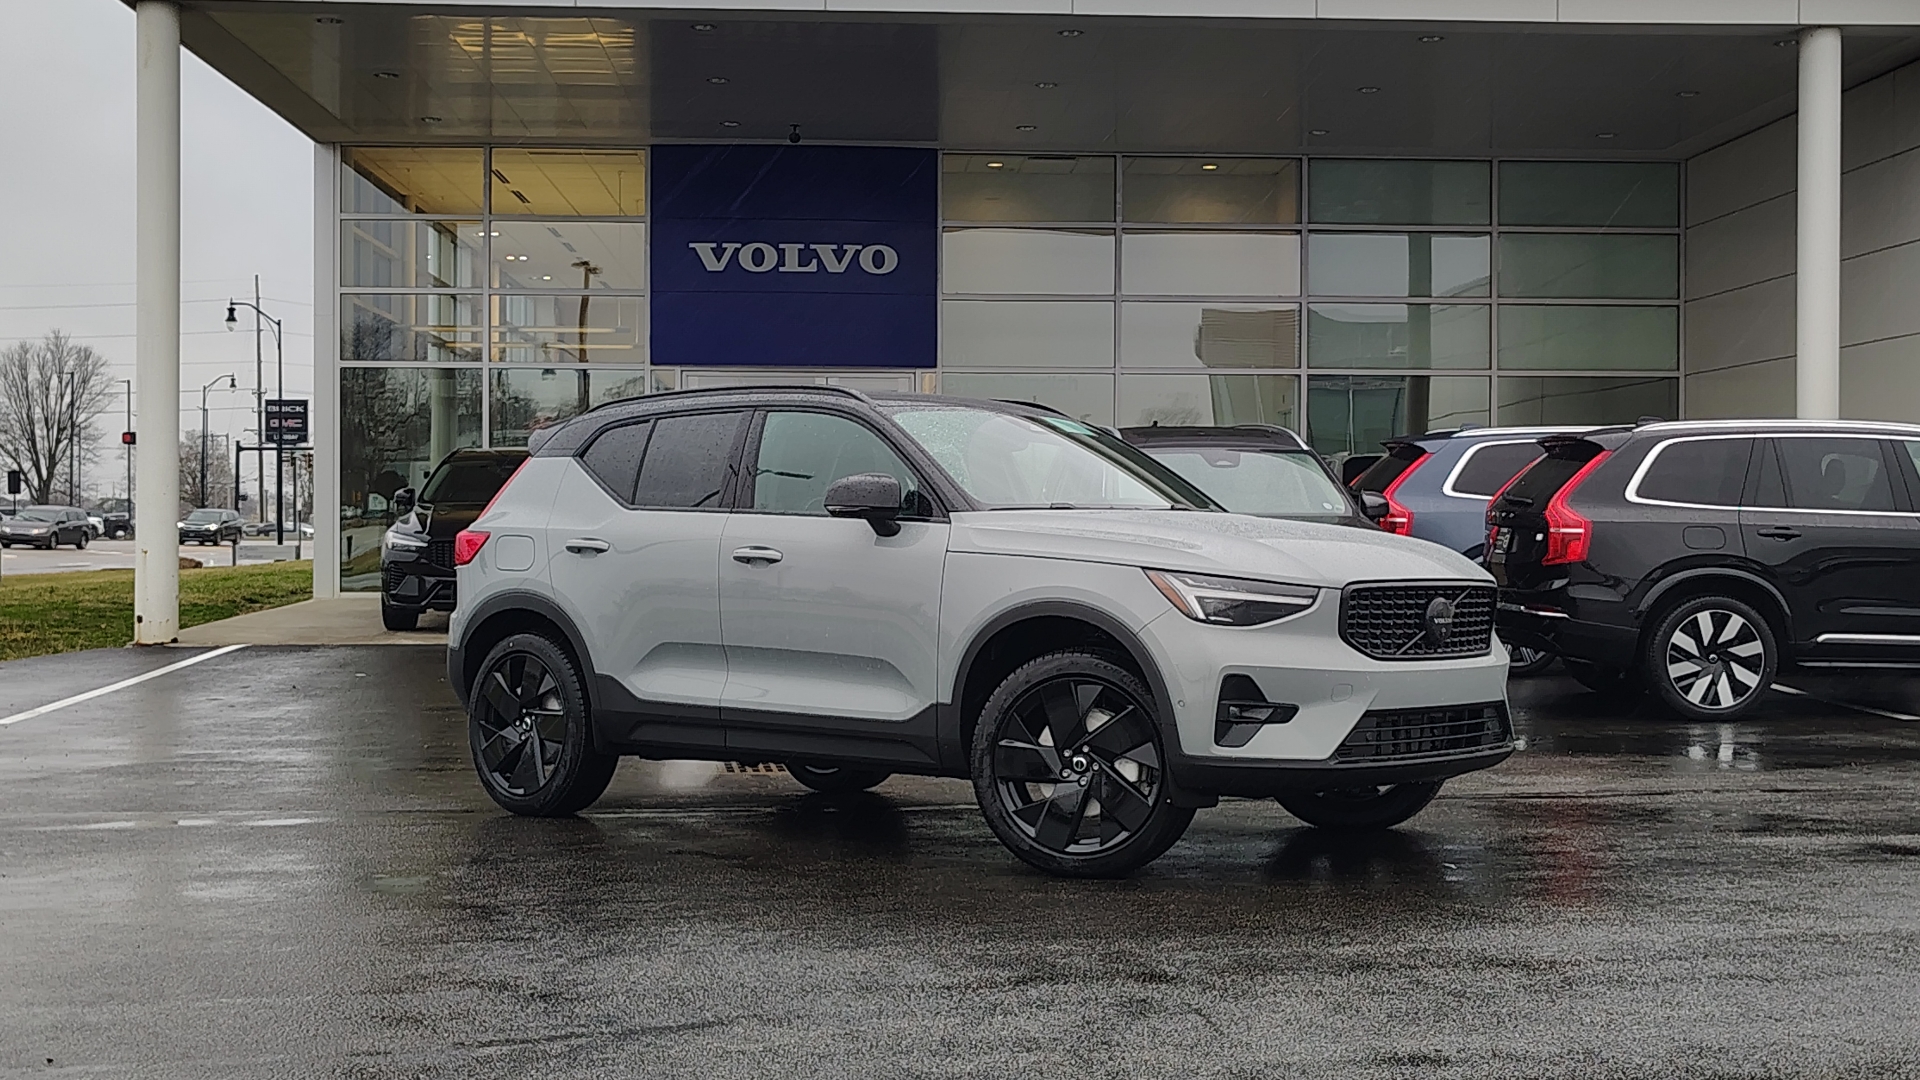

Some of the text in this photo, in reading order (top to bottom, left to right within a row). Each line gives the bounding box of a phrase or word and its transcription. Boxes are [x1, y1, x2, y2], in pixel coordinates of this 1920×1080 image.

[688, 243, 898, 275] VOLVO
[267, 405, 305, 413] BUICK
[270, 418, 303, 428] GMC
